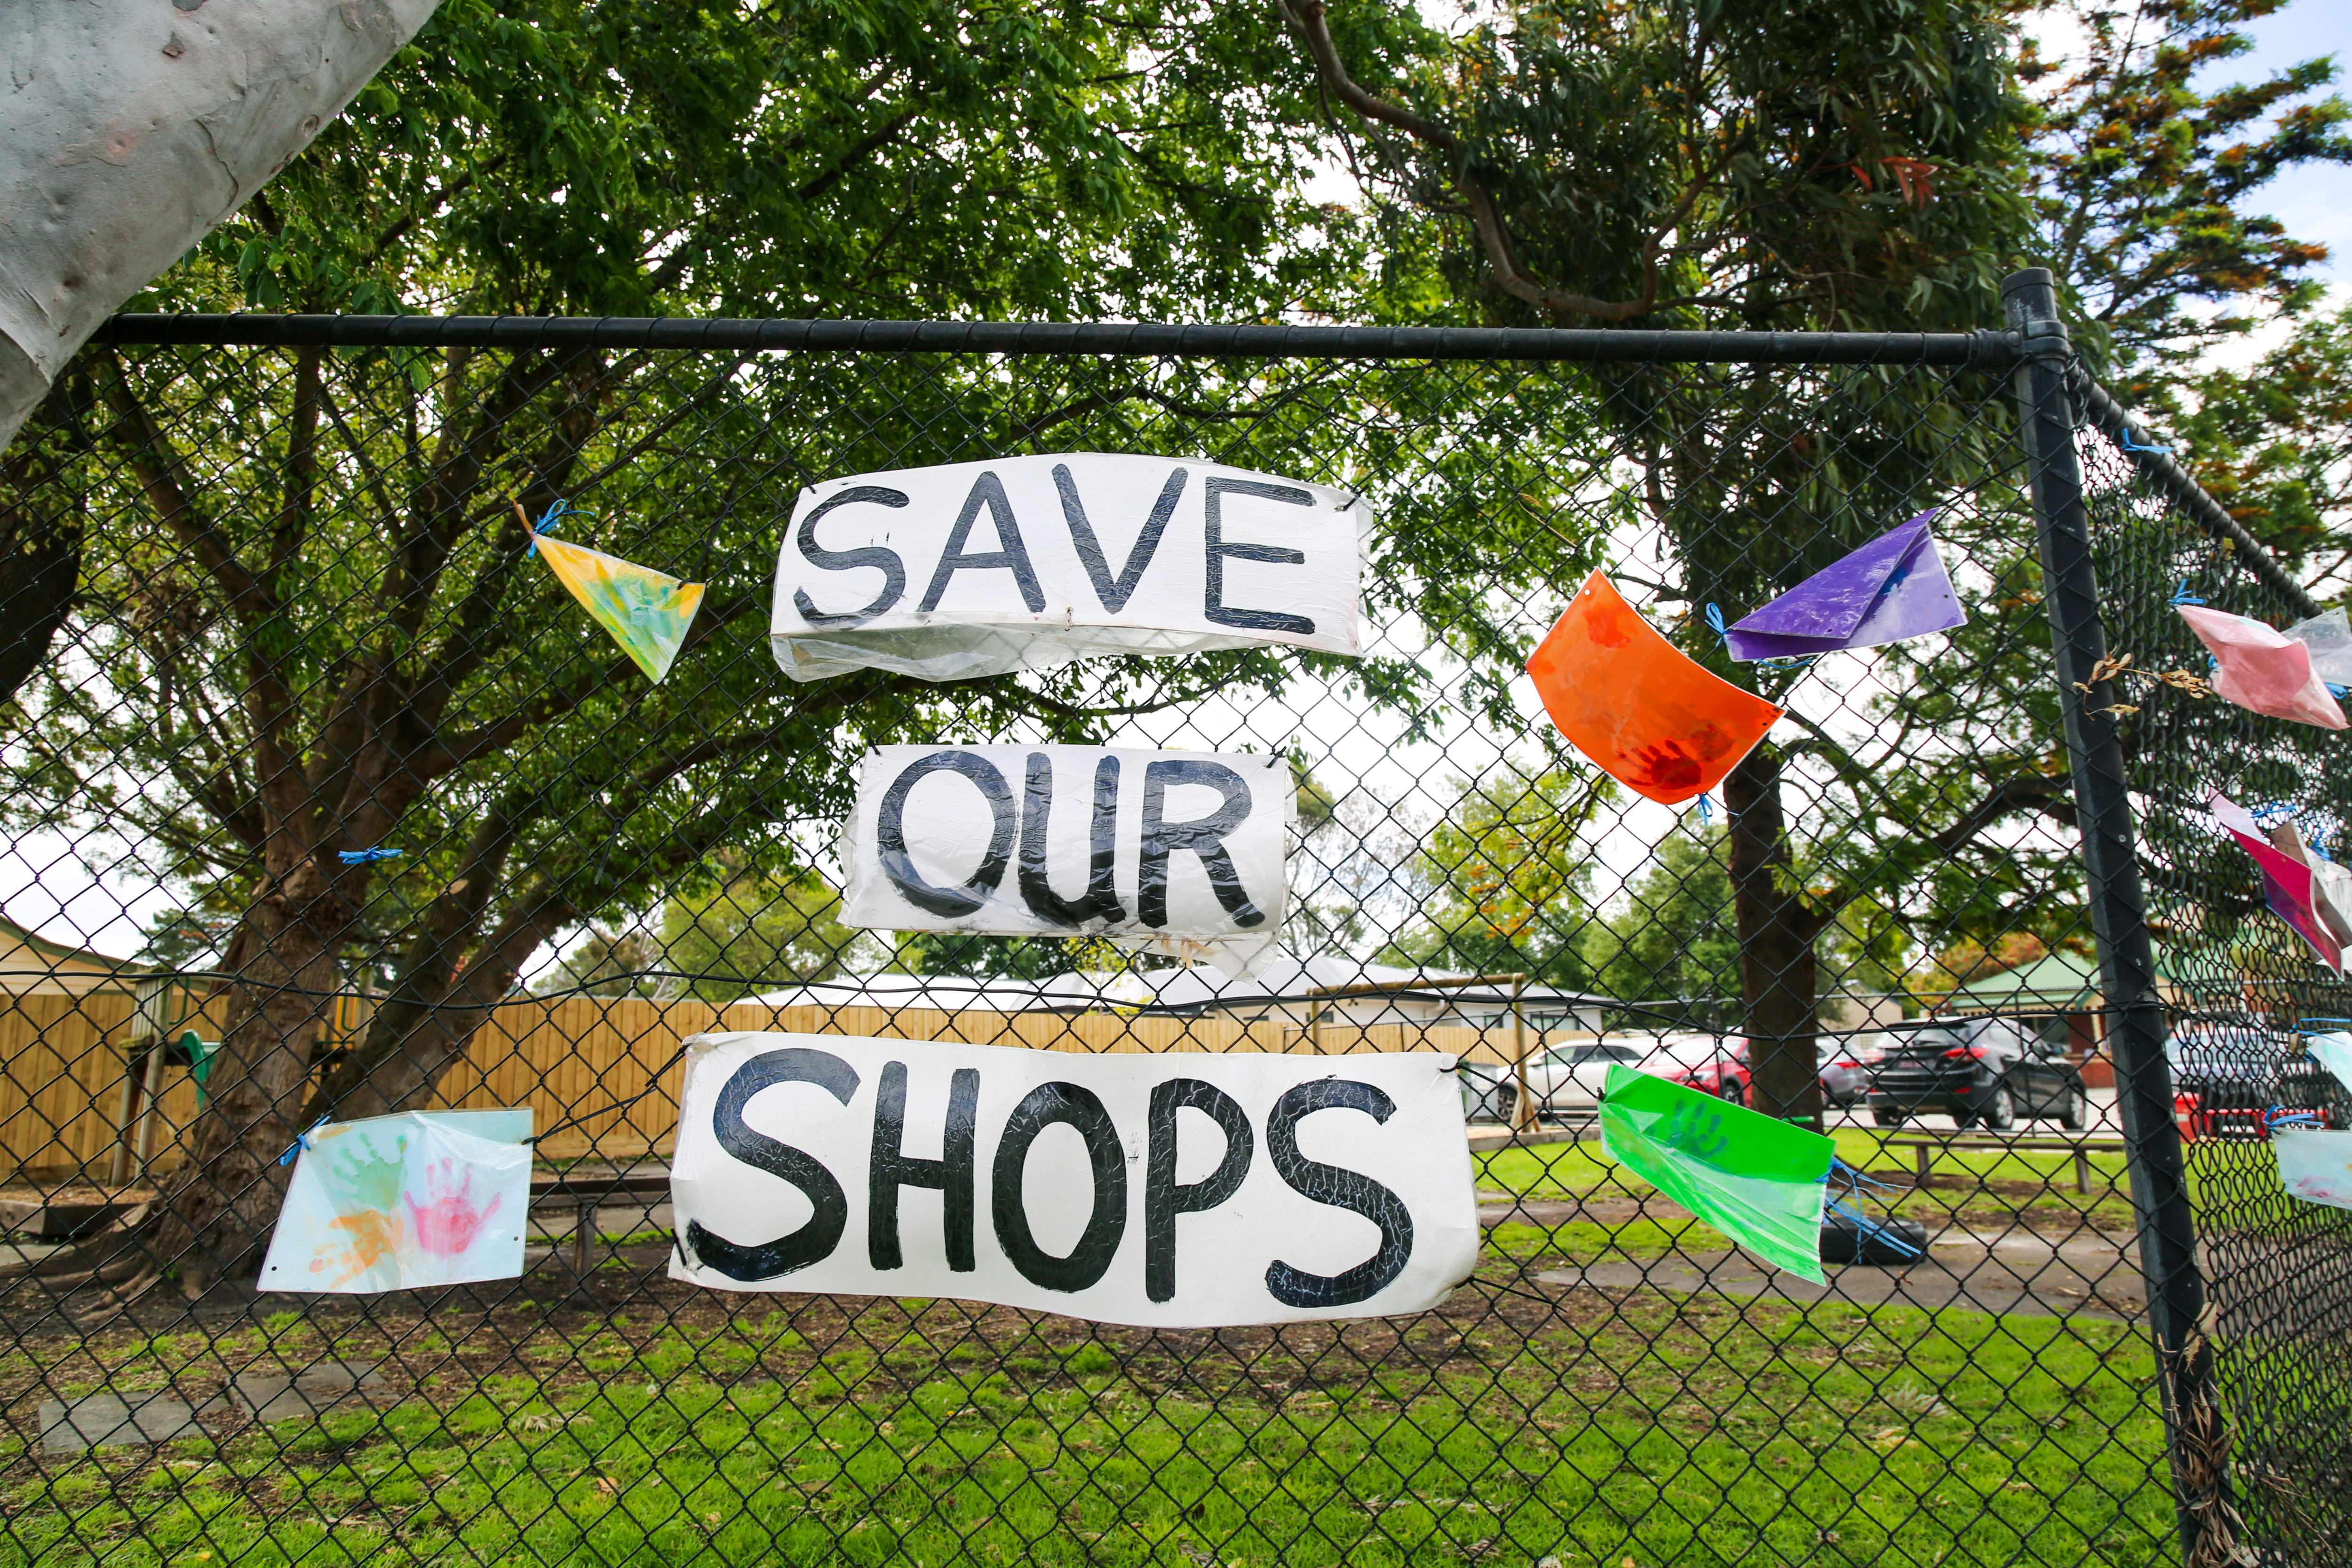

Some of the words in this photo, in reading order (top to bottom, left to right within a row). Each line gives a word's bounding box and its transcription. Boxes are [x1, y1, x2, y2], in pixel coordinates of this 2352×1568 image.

[792, 463, 1317, 635] SAVE
[877, 749, 1266, 929] OUR
[687, 1048, 1414, 1308] SHOPS
